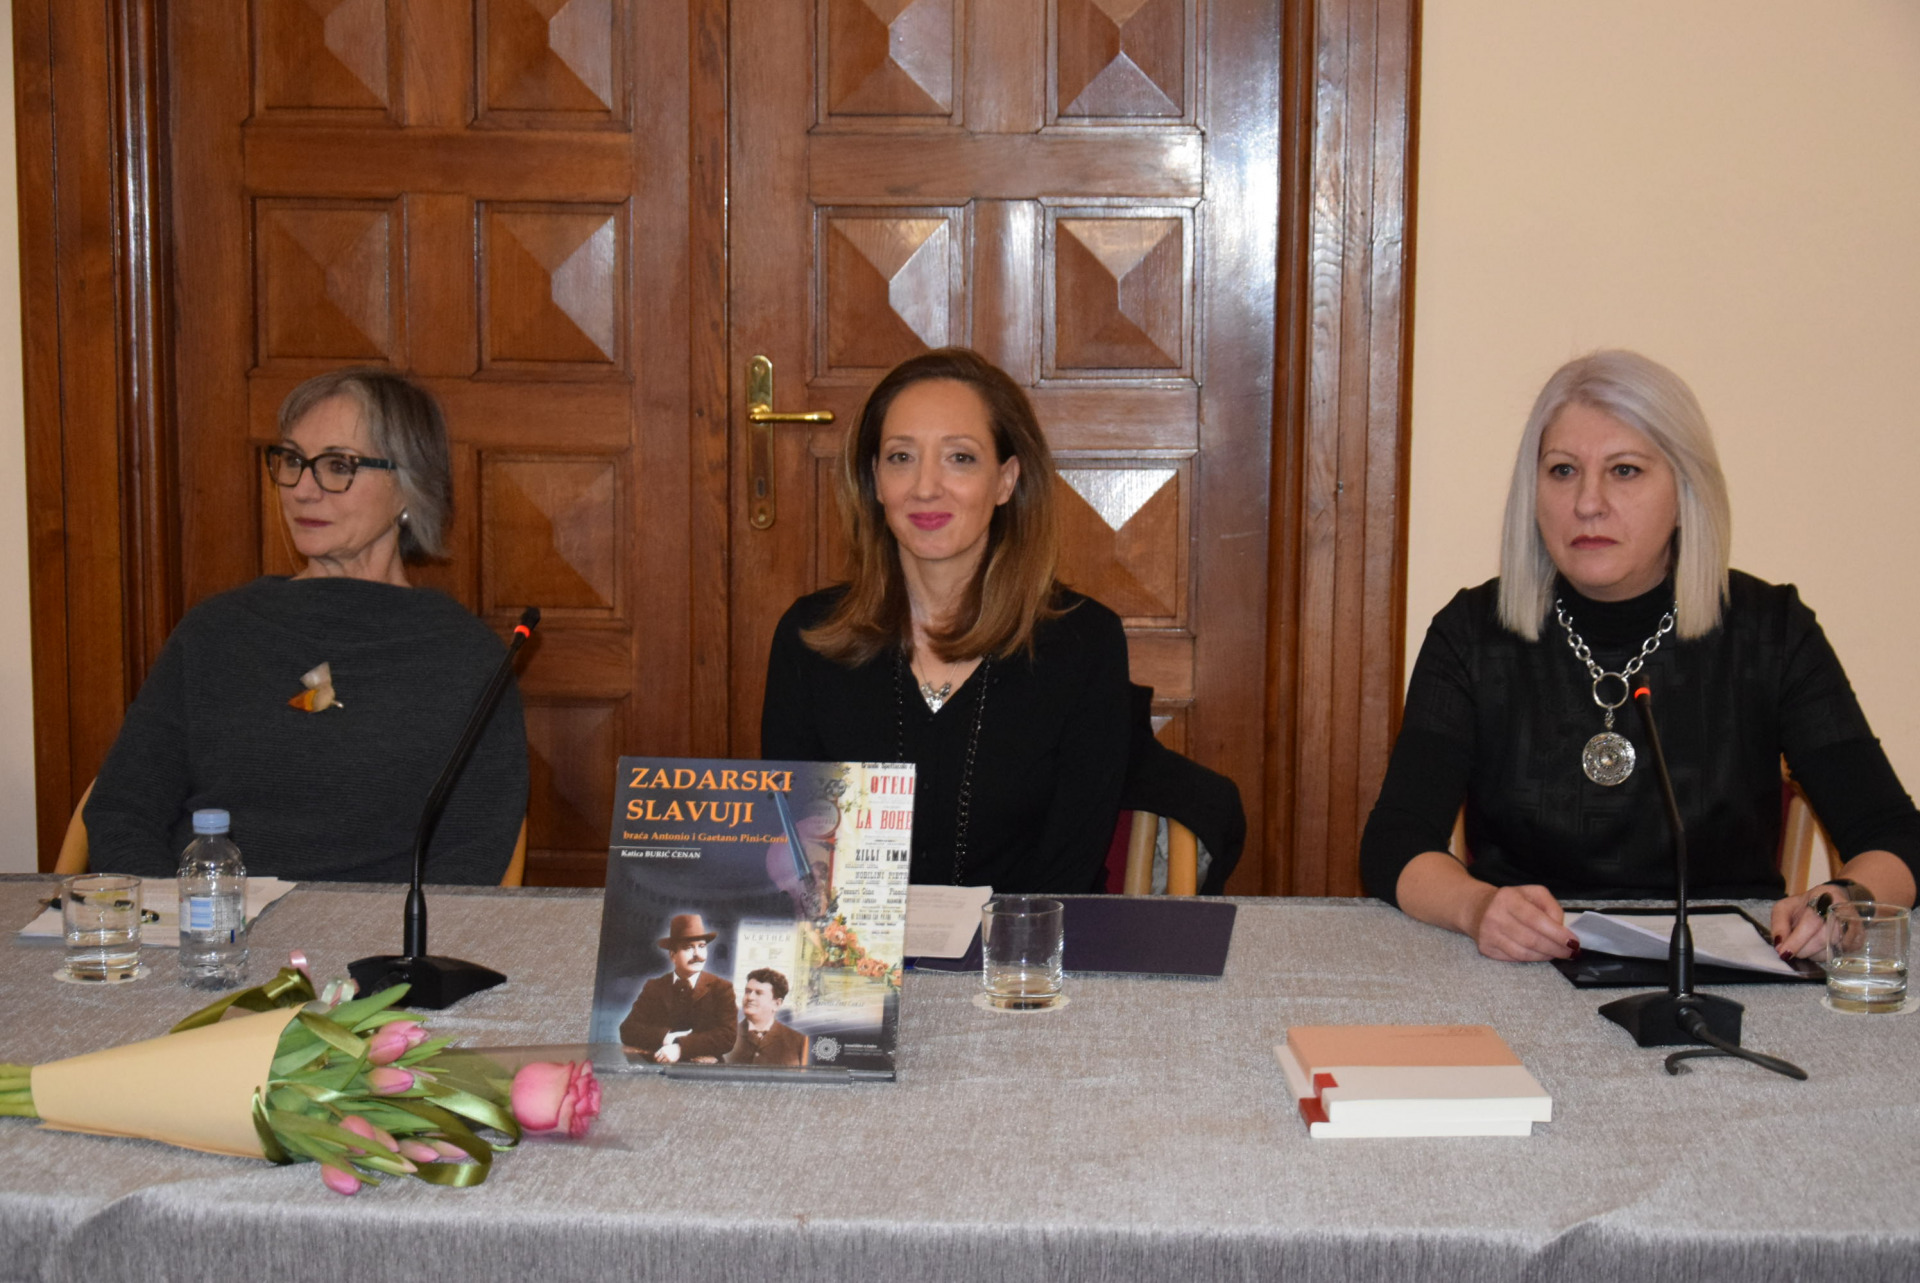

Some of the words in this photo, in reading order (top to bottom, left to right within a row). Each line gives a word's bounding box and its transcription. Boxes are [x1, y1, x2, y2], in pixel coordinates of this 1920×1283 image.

[628, 767, 793, 792] ZADARSKI
[626, 799, 755, 828] SLAVUJI
[856, 809, 872, 829] LA
[623, 830, 649, 841] braća
[651, 831, 690, 842] Antonio
[692, 832, 696, 842] i
[698, 833, 737, 843] Gaetano
[621, 849, 644, 858] Katica
